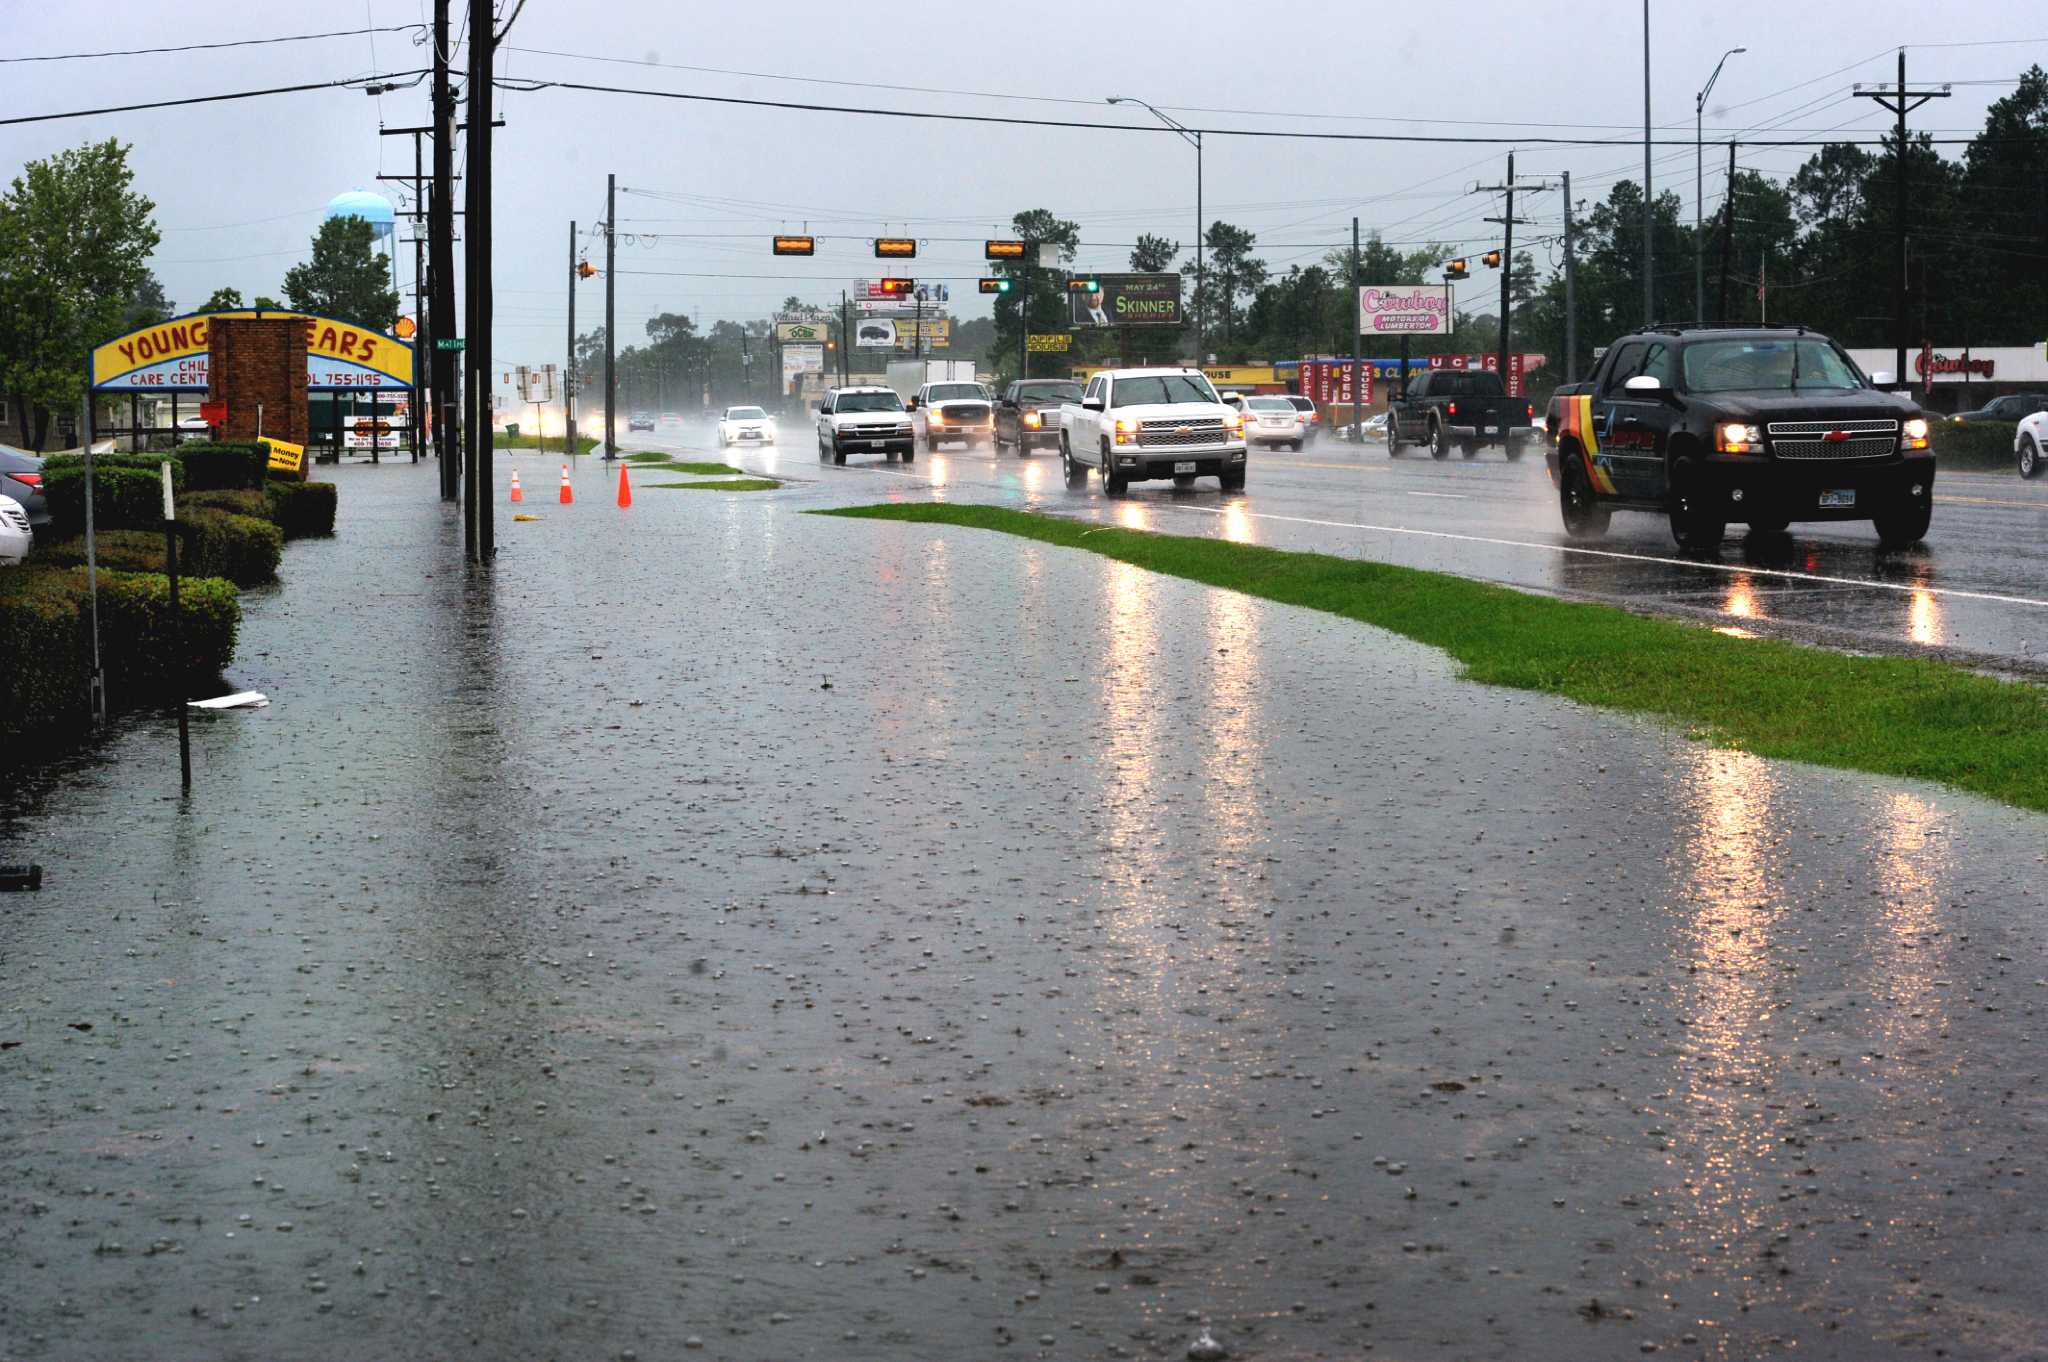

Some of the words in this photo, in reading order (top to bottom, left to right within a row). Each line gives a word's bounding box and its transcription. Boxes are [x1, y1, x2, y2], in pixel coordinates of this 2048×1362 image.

[1116, 296, 1175, 312] SKINNER
[1363, 289, 1449, 316] Cowboy
[118, 321, 209, 365] YOUNG
[306, 319, 377, 362] EARS
[1026, 334, 1072, 343] AFFLE
[179, 361, 209, 371] CHIL
[130, 374, 164, 385] CARE
[170, 374, 209, 385] CENT
[326, 373, 381, 385] 755-1195
[1204, 371, 1232, 379] OUSE
[1342, 364, 1352, 400] USED
[273, 447, 299, 459] Money
[279, 457, 297, 467] Now
